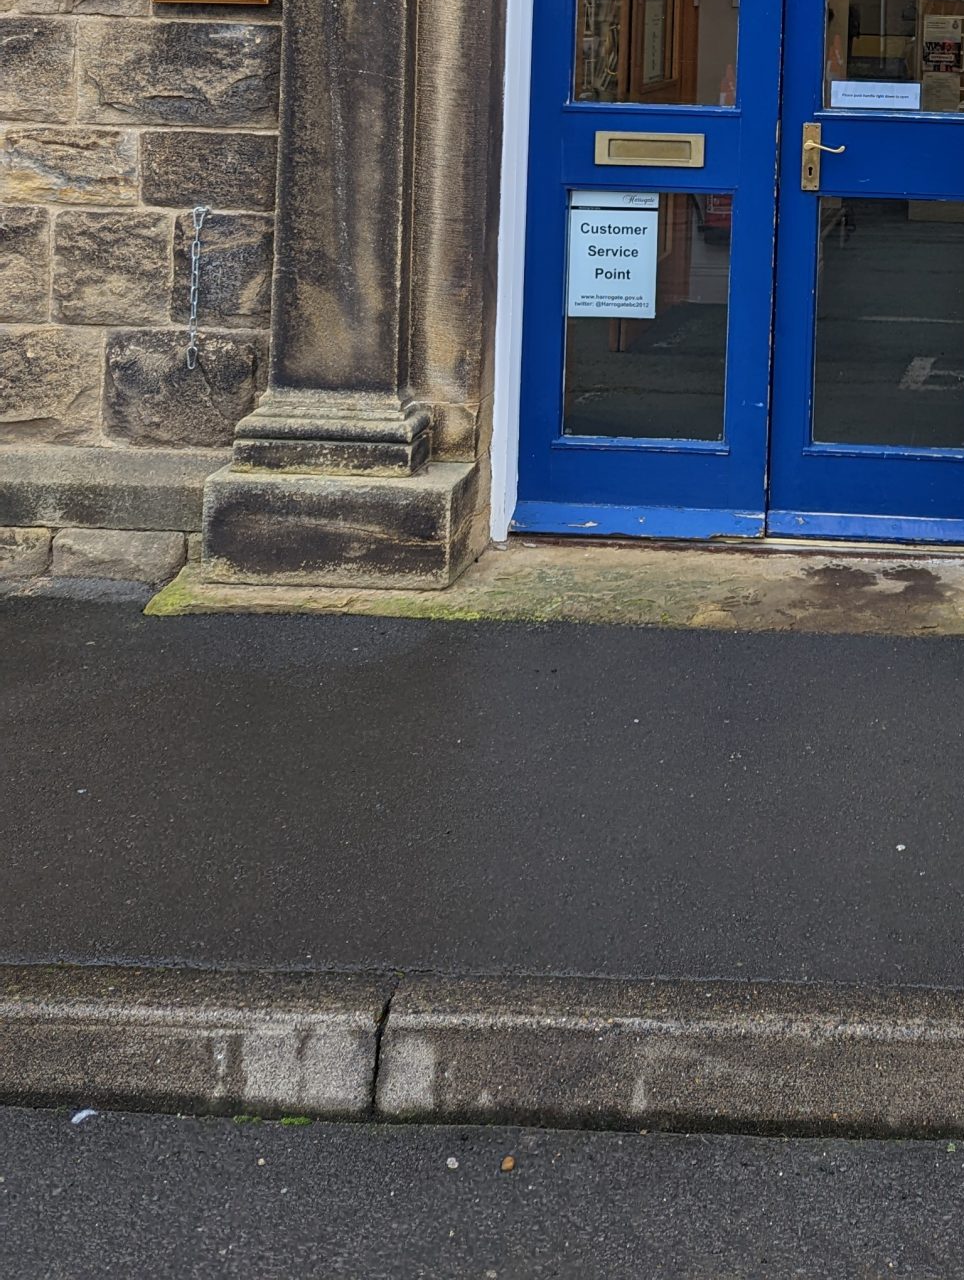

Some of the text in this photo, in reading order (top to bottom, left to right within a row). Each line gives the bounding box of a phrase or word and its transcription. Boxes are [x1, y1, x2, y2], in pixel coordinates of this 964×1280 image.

[580, 222, 648, 236] Customer
[587, 245, 639, 258] Service
[594, 268, 631, 280] Point
